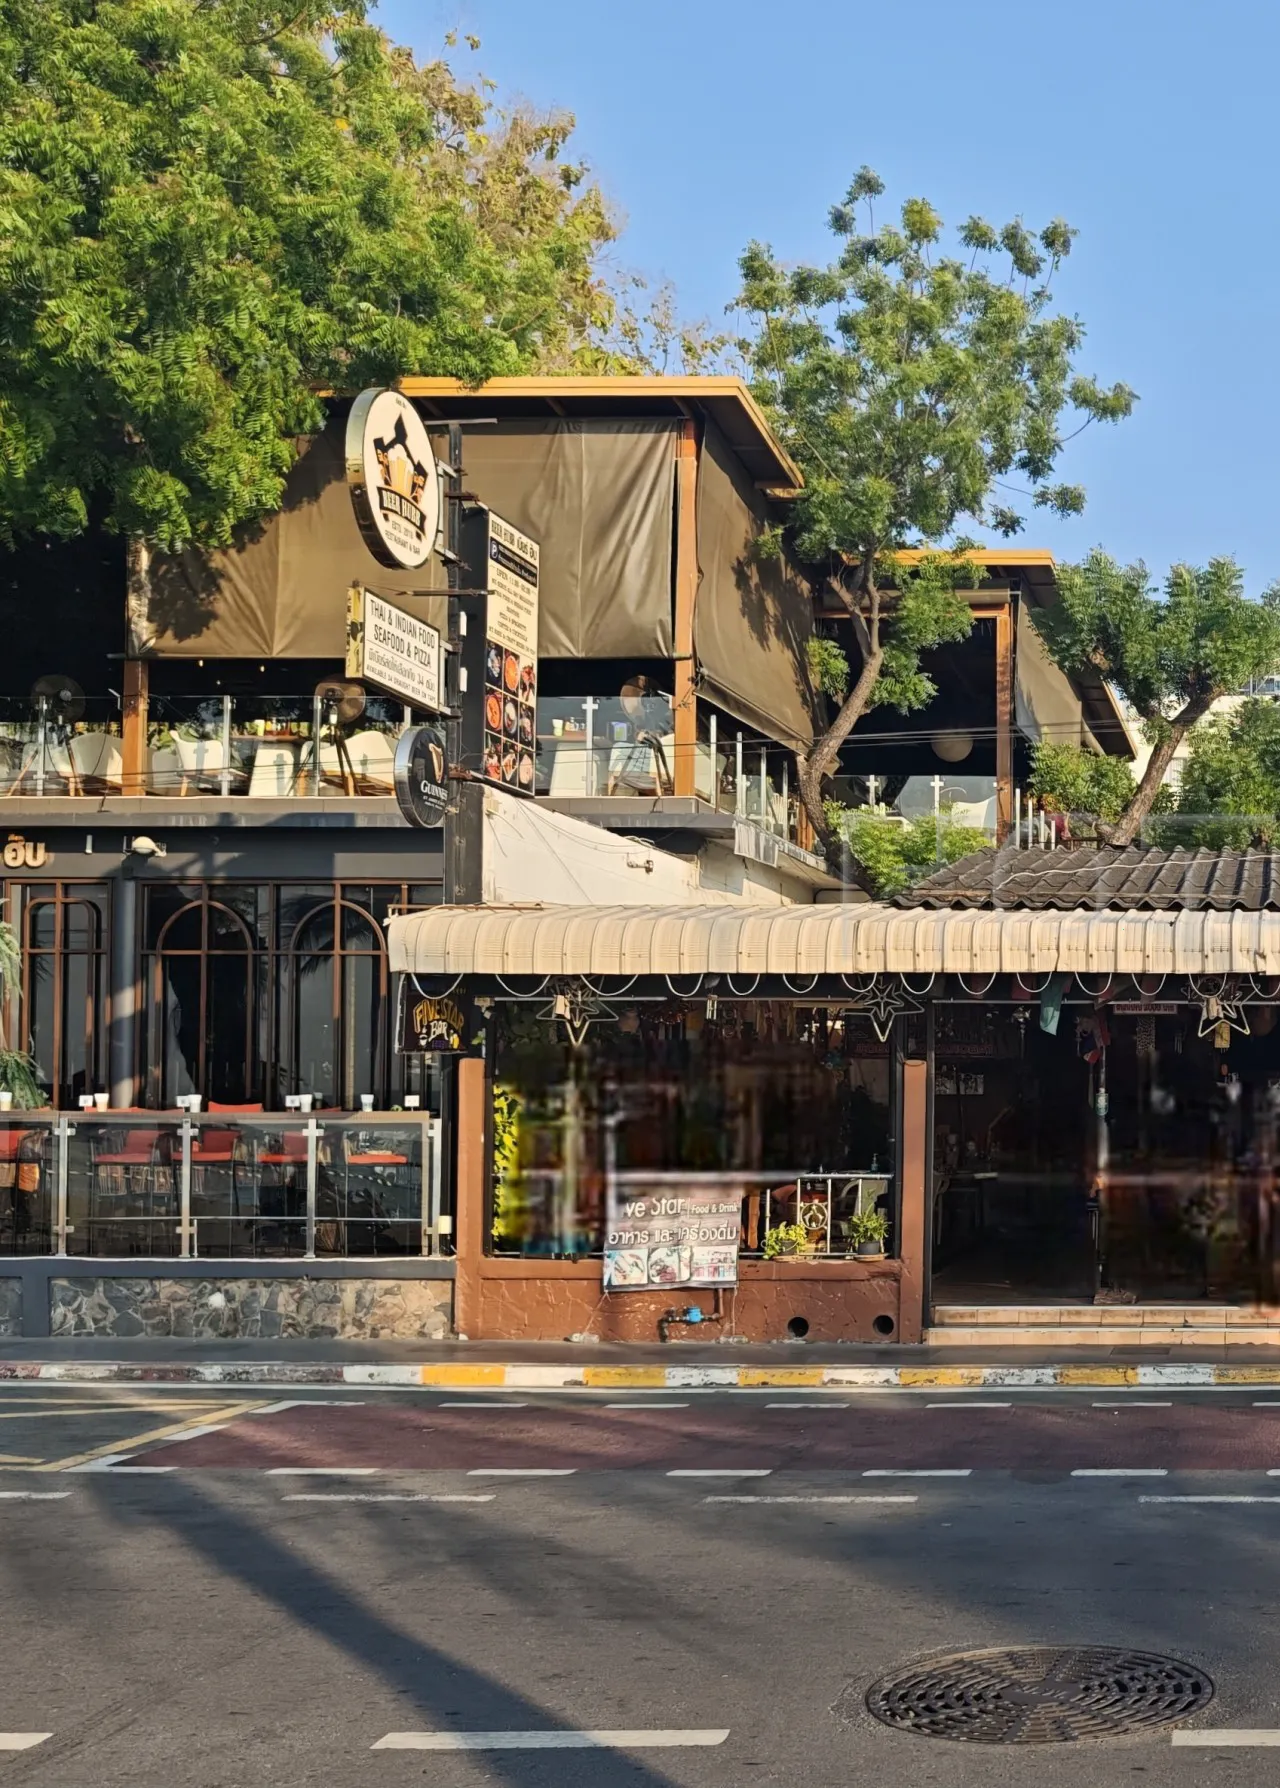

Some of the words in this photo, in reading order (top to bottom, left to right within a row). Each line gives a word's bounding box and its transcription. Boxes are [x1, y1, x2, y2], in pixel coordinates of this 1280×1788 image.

[371, 599, 386, 622] THAI
[388, 609, 393, 625] &
[395, 613, 417, 639] INDIAN
[419, 627, 435, 649] FOOD
[374, 624, 405, 654] SEAFOOD
[407, 642, 411, 658] &
[414, 646, 431, 668] PIZZA
[417, 673, 424, 686] 34
[413, 999, 440, 1033] FIVE
[428, 1020, 448, 1041] BAR
[691, 1205, 709, 1215] Food
[711, 1204, 717, 1214] &
[719, 1202, 738, 1214] Drink
[608, 1229, 649, 1245] อาหาร
